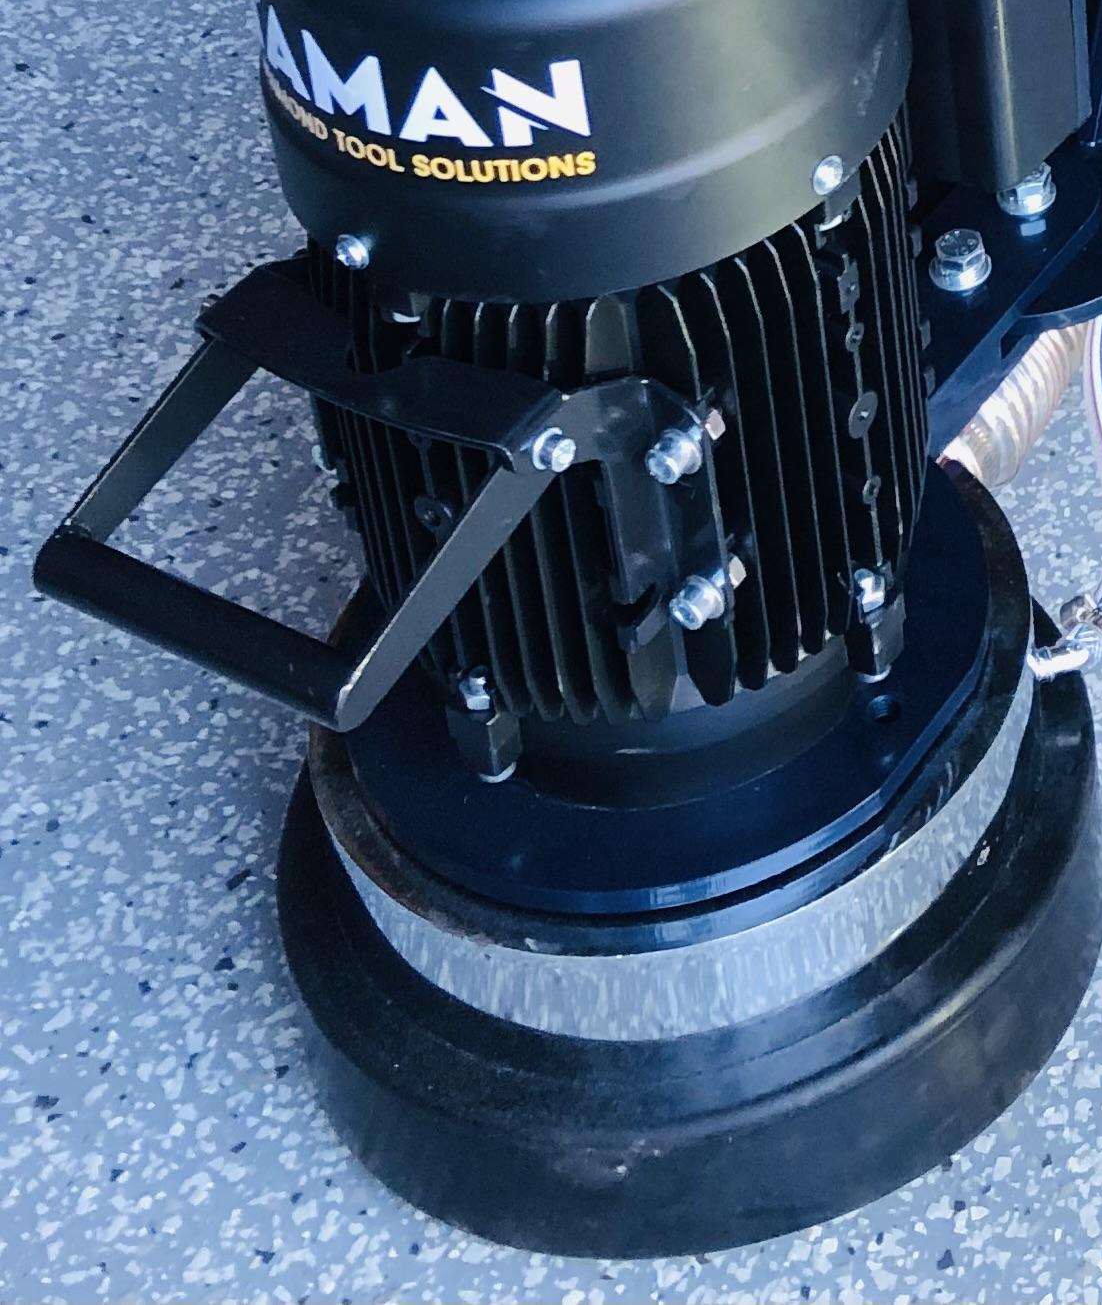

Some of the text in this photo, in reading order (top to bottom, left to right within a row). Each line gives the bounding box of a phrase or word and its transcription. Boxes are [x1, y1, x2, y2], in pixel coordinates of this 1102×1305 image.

[266, 4, 592, 148] AMAN
[332, 127, 405, 173] TOOL
[411, 151, 597, 184] SOLUTIONS
